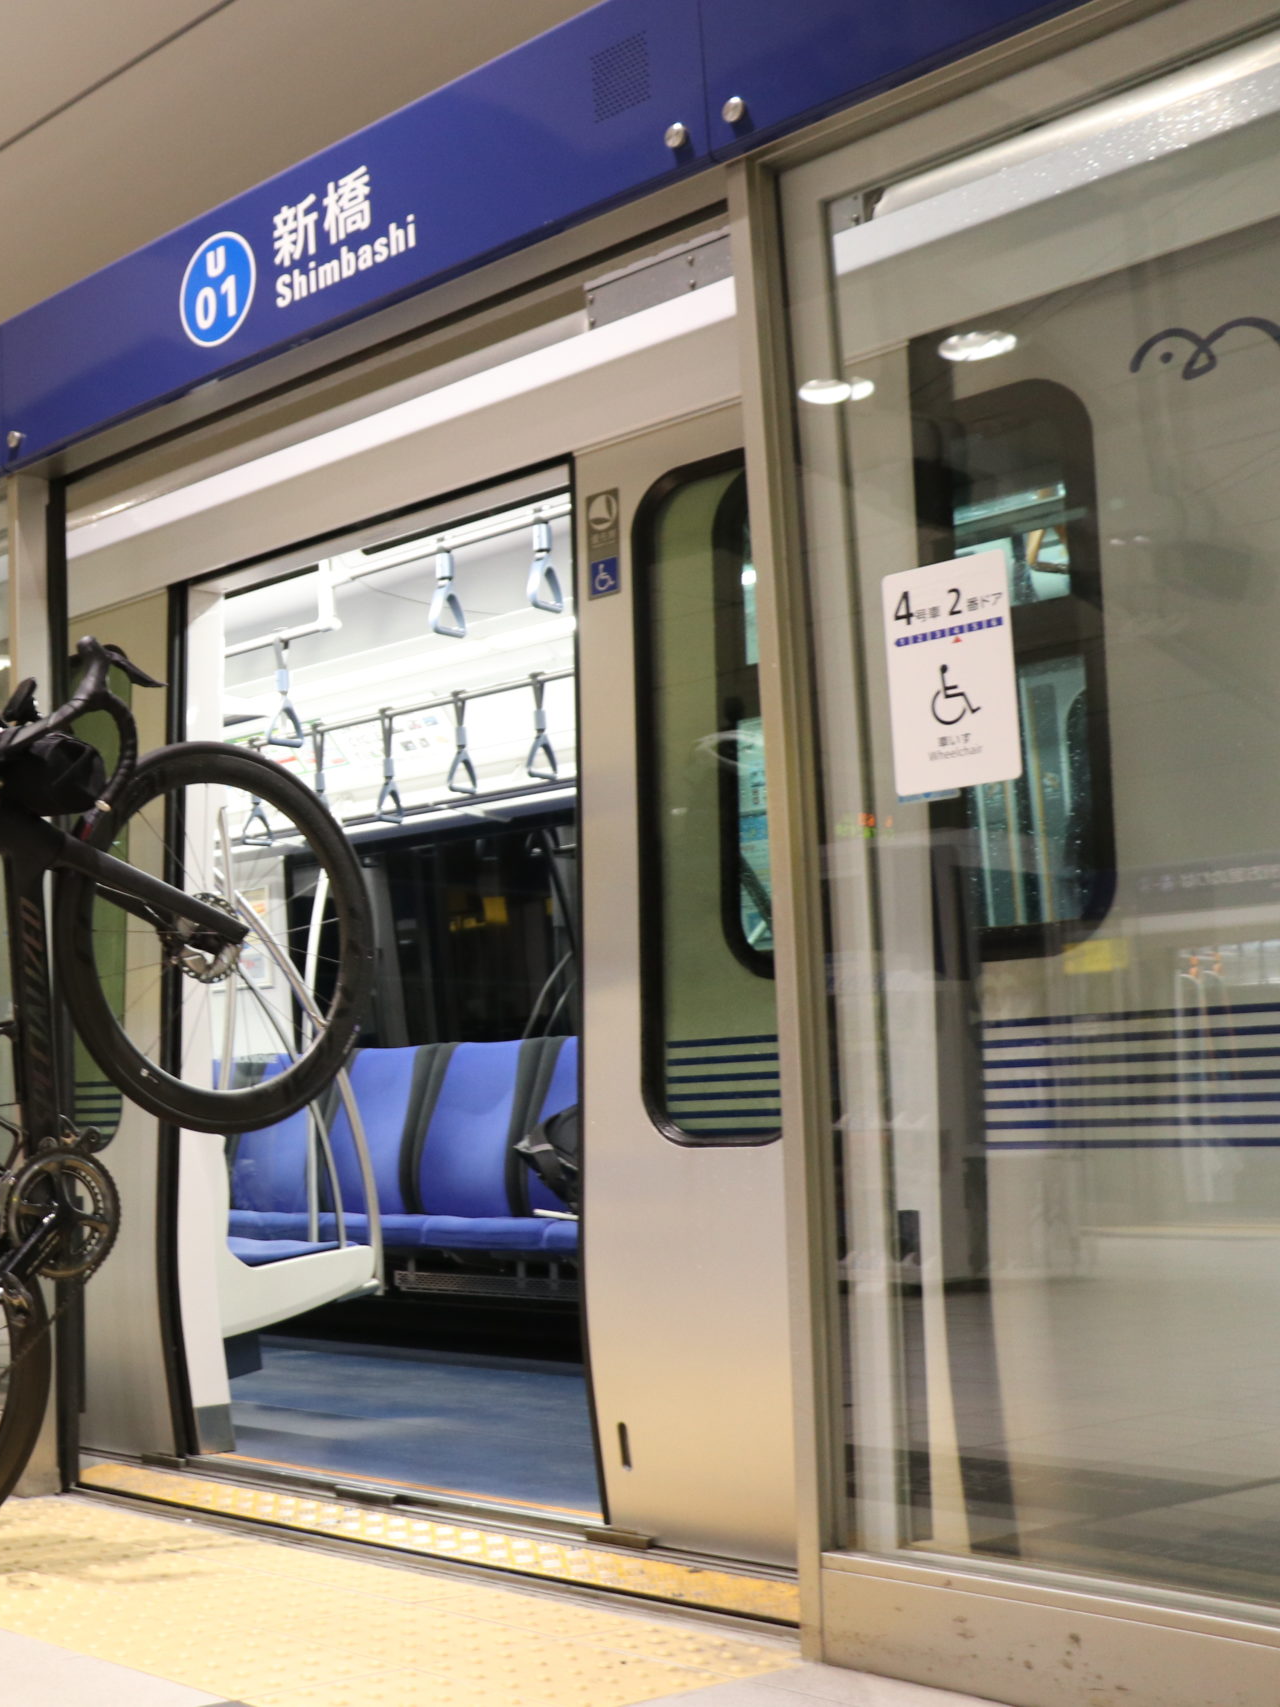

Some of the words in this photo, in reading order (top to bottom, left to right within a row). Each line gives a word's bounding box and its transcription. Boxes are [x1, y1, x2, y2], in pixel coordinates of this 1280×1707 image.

[272, 165, 371, 268] 新橋
[205, 245, 226, 279] U
[275, 213, 417, 309] Shimbashi
[195, 274, 238, 331] 01
[928, 743, 984, 762] Wheelchair
